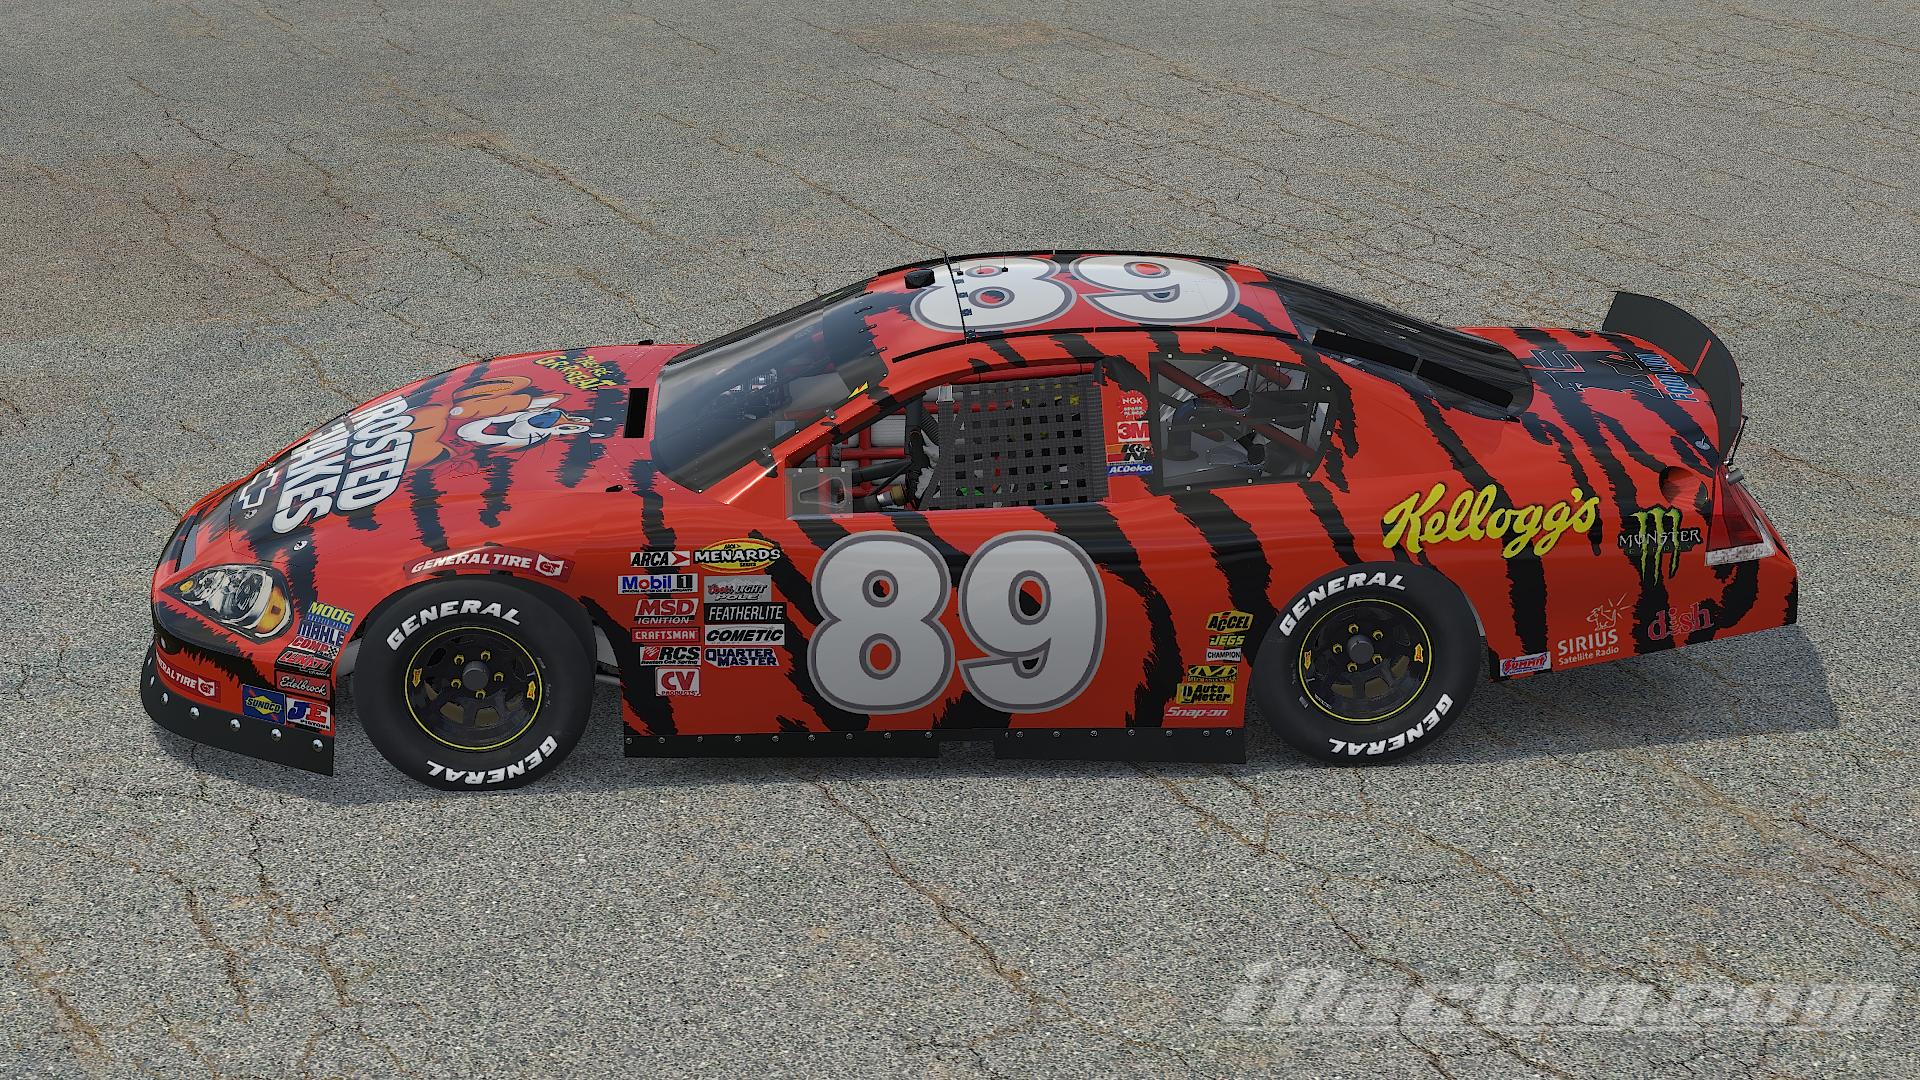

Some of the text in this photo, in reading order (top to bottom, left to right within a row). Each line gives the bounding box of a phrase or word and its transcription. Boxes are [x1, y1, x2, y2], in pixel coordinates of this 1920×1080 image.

[909, 255, 1241, 333] 89
[1118, 423, 1150, 440] 3M
[1109, 465, 1153, 474] ACDelco
[1383, 483, 1600, 559] Kellogg's
[1620, 529, 1701, 548] MONSTER
[411, 553, 491, 574] GENERAL
[492, 554, 533, 569] TIRE
[630, 552, 669, 567] ARCA
[694, 549, 781, 563] MENARDS
[622, 575, 672, 590] Mobil
[308, 601, 355, 625] MOOG
[637, 600, 695, 616] MSD
[709, 605, 784, 621] FEATHERLITE
[1278, 572, 1406, 637] GENERAL
[386, 599, 521, 651] GENERAL
[807, 530, 1107, 715] 89
[1647, 602, 1715, 641] dish
[299, 622, 345, 647] MAHLE
[635, 630, 697, 640] CRAFTSMAN
[706, 629, 784, 641] COMETIC
[1209, 635, 1245, 646] JEGS
[1557, 628, 1619, 657] SIRIUS
[658, 646, 701, 660] RCS
[705, 648, 773, 661] QUARTER
[1207, 651, 1241, 659] CHAMPION
[1558, 646, 1620, 666] Satellite Radio
[717, 657, 777, 667] MASTER
[175, 672, 197, 689] TIRE
[280, 676, 327, 696] Edelbrock
[661, 671, 696, 691] CV
[1194, 684, 1226, 694] Auto
[246, 698, 282, 714] SUNOCO
[1192, 693, 1231, 702] Meter
[288, 701, 328, 724] JE
[1165, 706, 1229, 719] Snap-on
[1328, 693, 1454, 756] GENERAL
[427, 735, 558, 785] GENERAL
